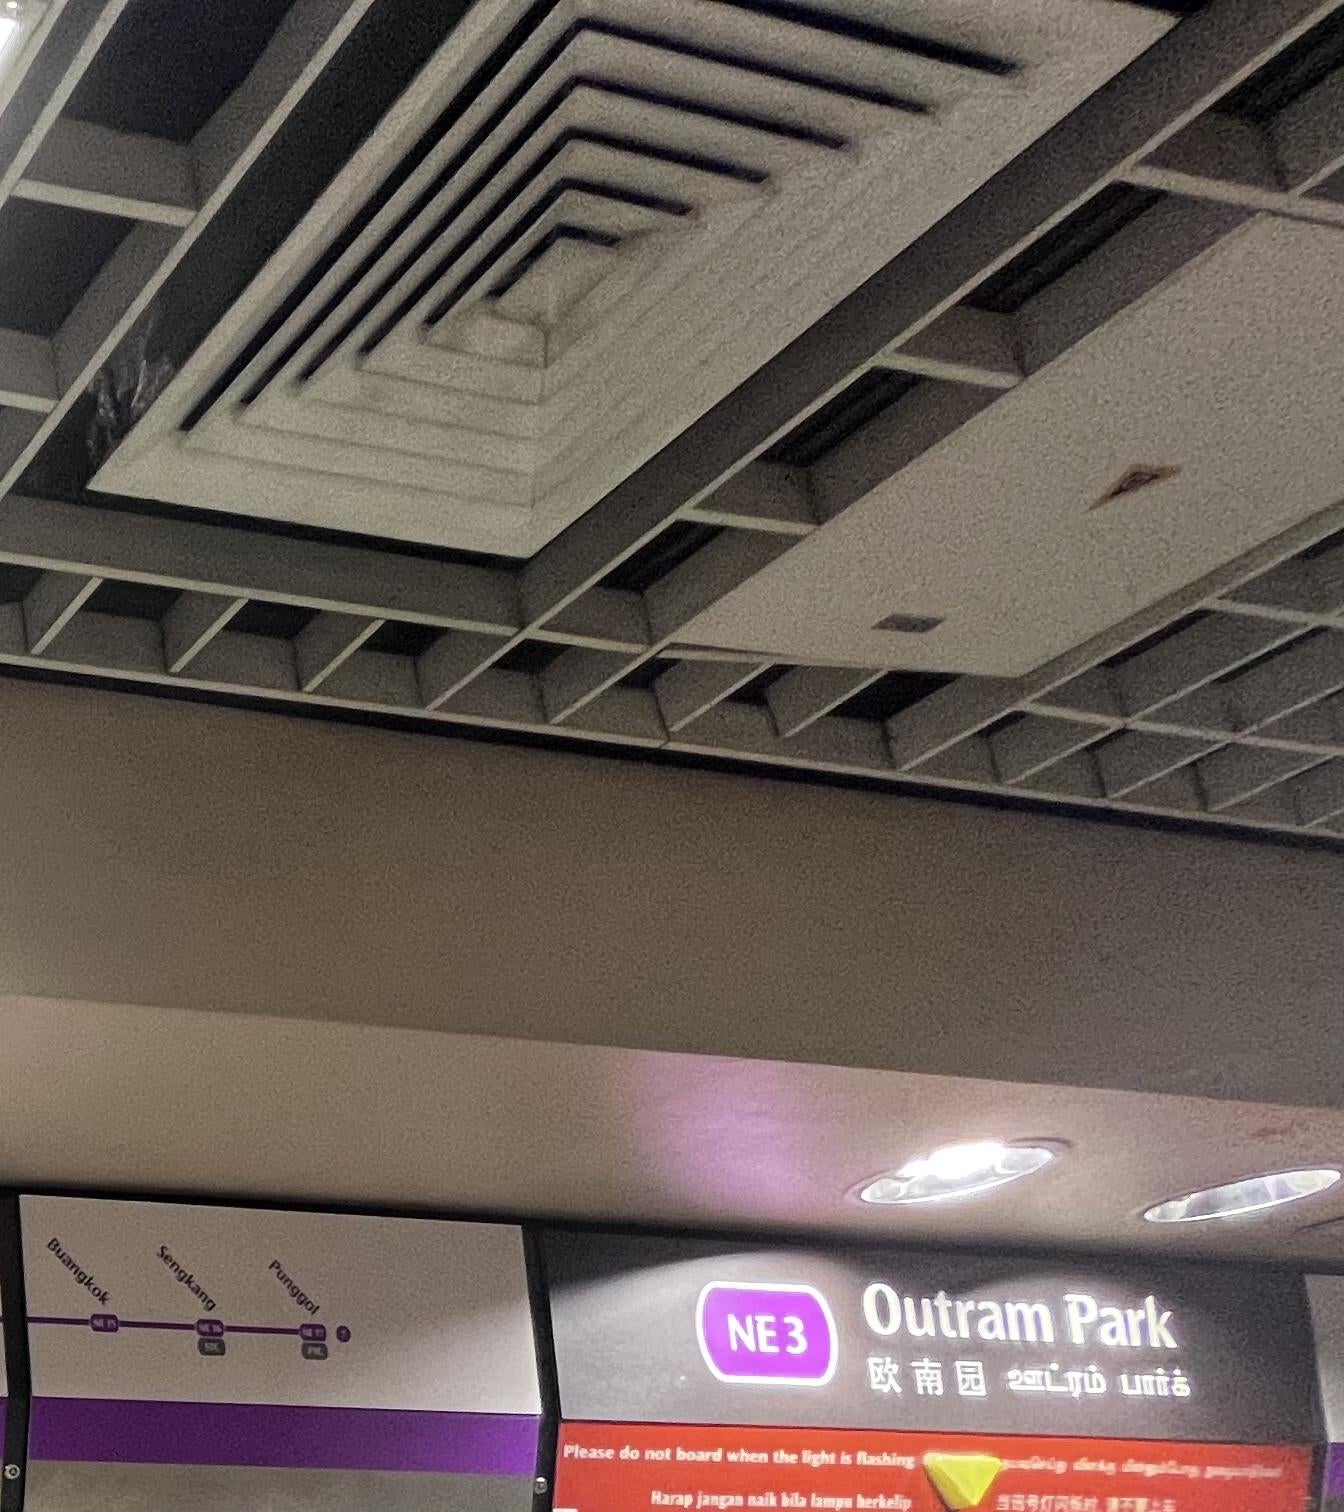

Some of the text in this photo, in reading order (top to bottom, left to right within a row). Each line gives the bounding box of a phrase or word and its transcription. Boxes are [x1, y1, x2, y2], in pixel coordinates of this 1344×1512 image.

[47, 1237, 111, 1305] Buangkok
[156, 1245, 217, 1311] Sengkang
[268, 1259, 321, 1315] Punggol
[862, 1281, 1178, 1349] Outram Park
[866, 1355, 988, 1397] 欧南园
[562, 1443, 916, 1470] Please do not board when the light is flashing
[651, 1489, 694, 1509] Harap
[696, 1490, 744, 1510] jangan
[747, 1491, 777, 1508] naik
[780, 1491, 807, 1508] bila
